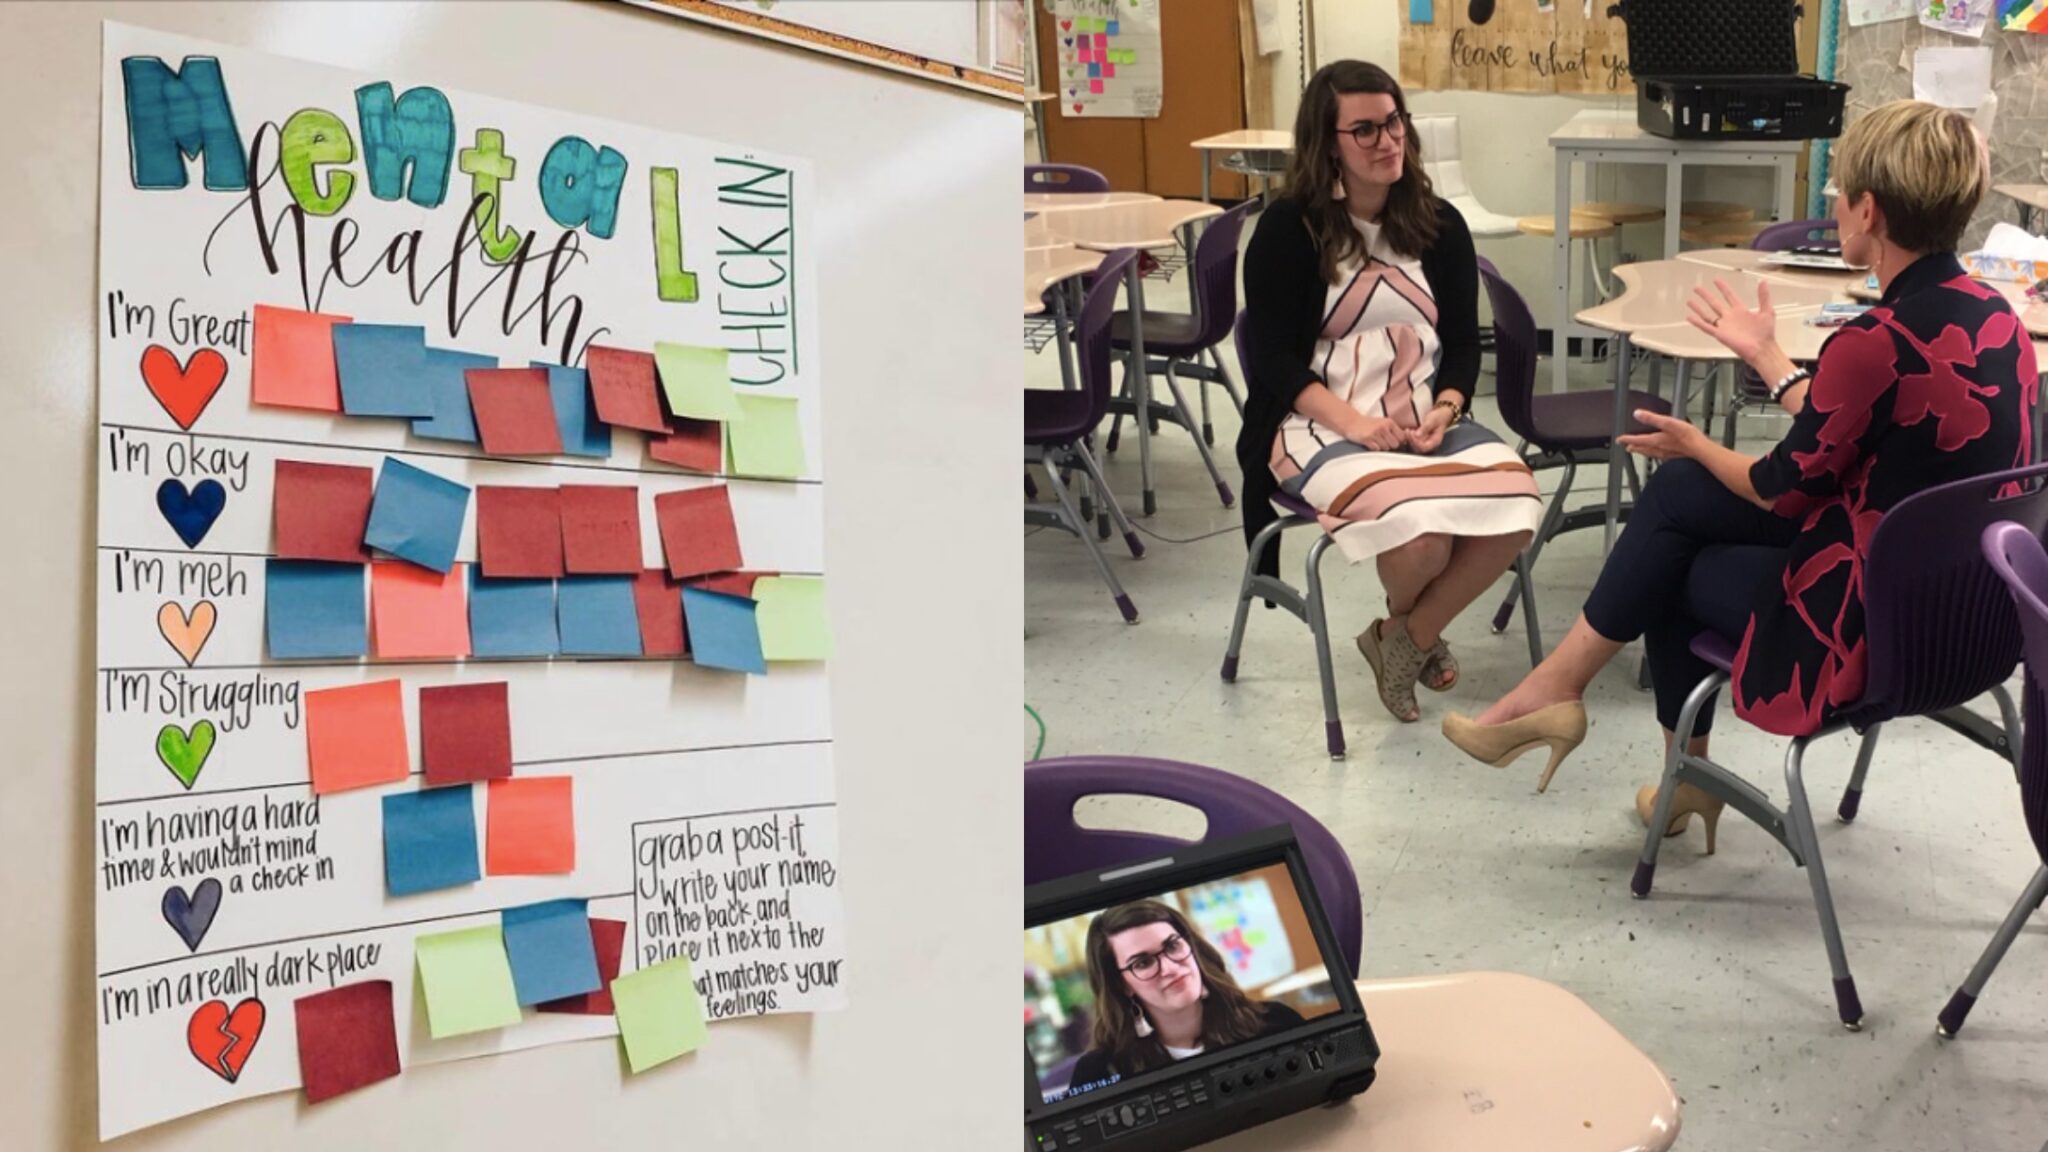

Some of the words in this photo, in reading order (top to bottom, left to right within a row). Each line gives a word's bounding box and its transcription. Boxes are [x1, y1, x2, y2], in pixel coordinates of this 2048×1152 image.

[1451, 28, 1518, 68] leave
[1529, 41, 1591, 79] what
[1602, 53, 1630, 90] yo
[204, 121, 612, 367] health
[109, 290, 155, 338] I'm
[168, 298, 251, 356] Great
[715, 226, 790, 385] CHECK
[110, 428, 150, 476] I'm
[115, 550, 164, 594] I'm
[179, 555, 247, 597] meh
[105, 669, 151, 713] I'm
[159, 670, 300, 732] Struggling
[102, 818, 139, 858] I'm
[146, 805, 239, 850] having
[242, 805, 257, 831] a
[264, 794, 320, 830] hard
[102, 856, 155, 891] time
[160, 848, 175, 879] &
[178, 835, 260, 878] wouldn't
[266, 829, 317, 863] mind
[230, 874, 243, 893] a
[252, 863, 309, 892] check
[316, 855, 334, 881] in
[639, 821, 703, 899] grab
[707, 829, 723, 854] a
[660, 868, 718, 914] write
[724, 862, 771, 905] your
[779, 859, 836, 887] name
[646, 911, 670, 938] on
[672, 907, 701, 938] the
[757, 888, 791, 921] and
[707, 931, 720, 957] it
[788, 921, 824, 949] the
[102, 986, 139, 1025] I'm
[147, 978, 171, 1014] in
[178, 973, 192, 1005] a
[197, 956, 258, 1000] really
[265, 951, 324, 986] dark
[327, 942, 382, 987] place
[715, 960, 789, 993] matches
[795, 958, 843, 993] your
